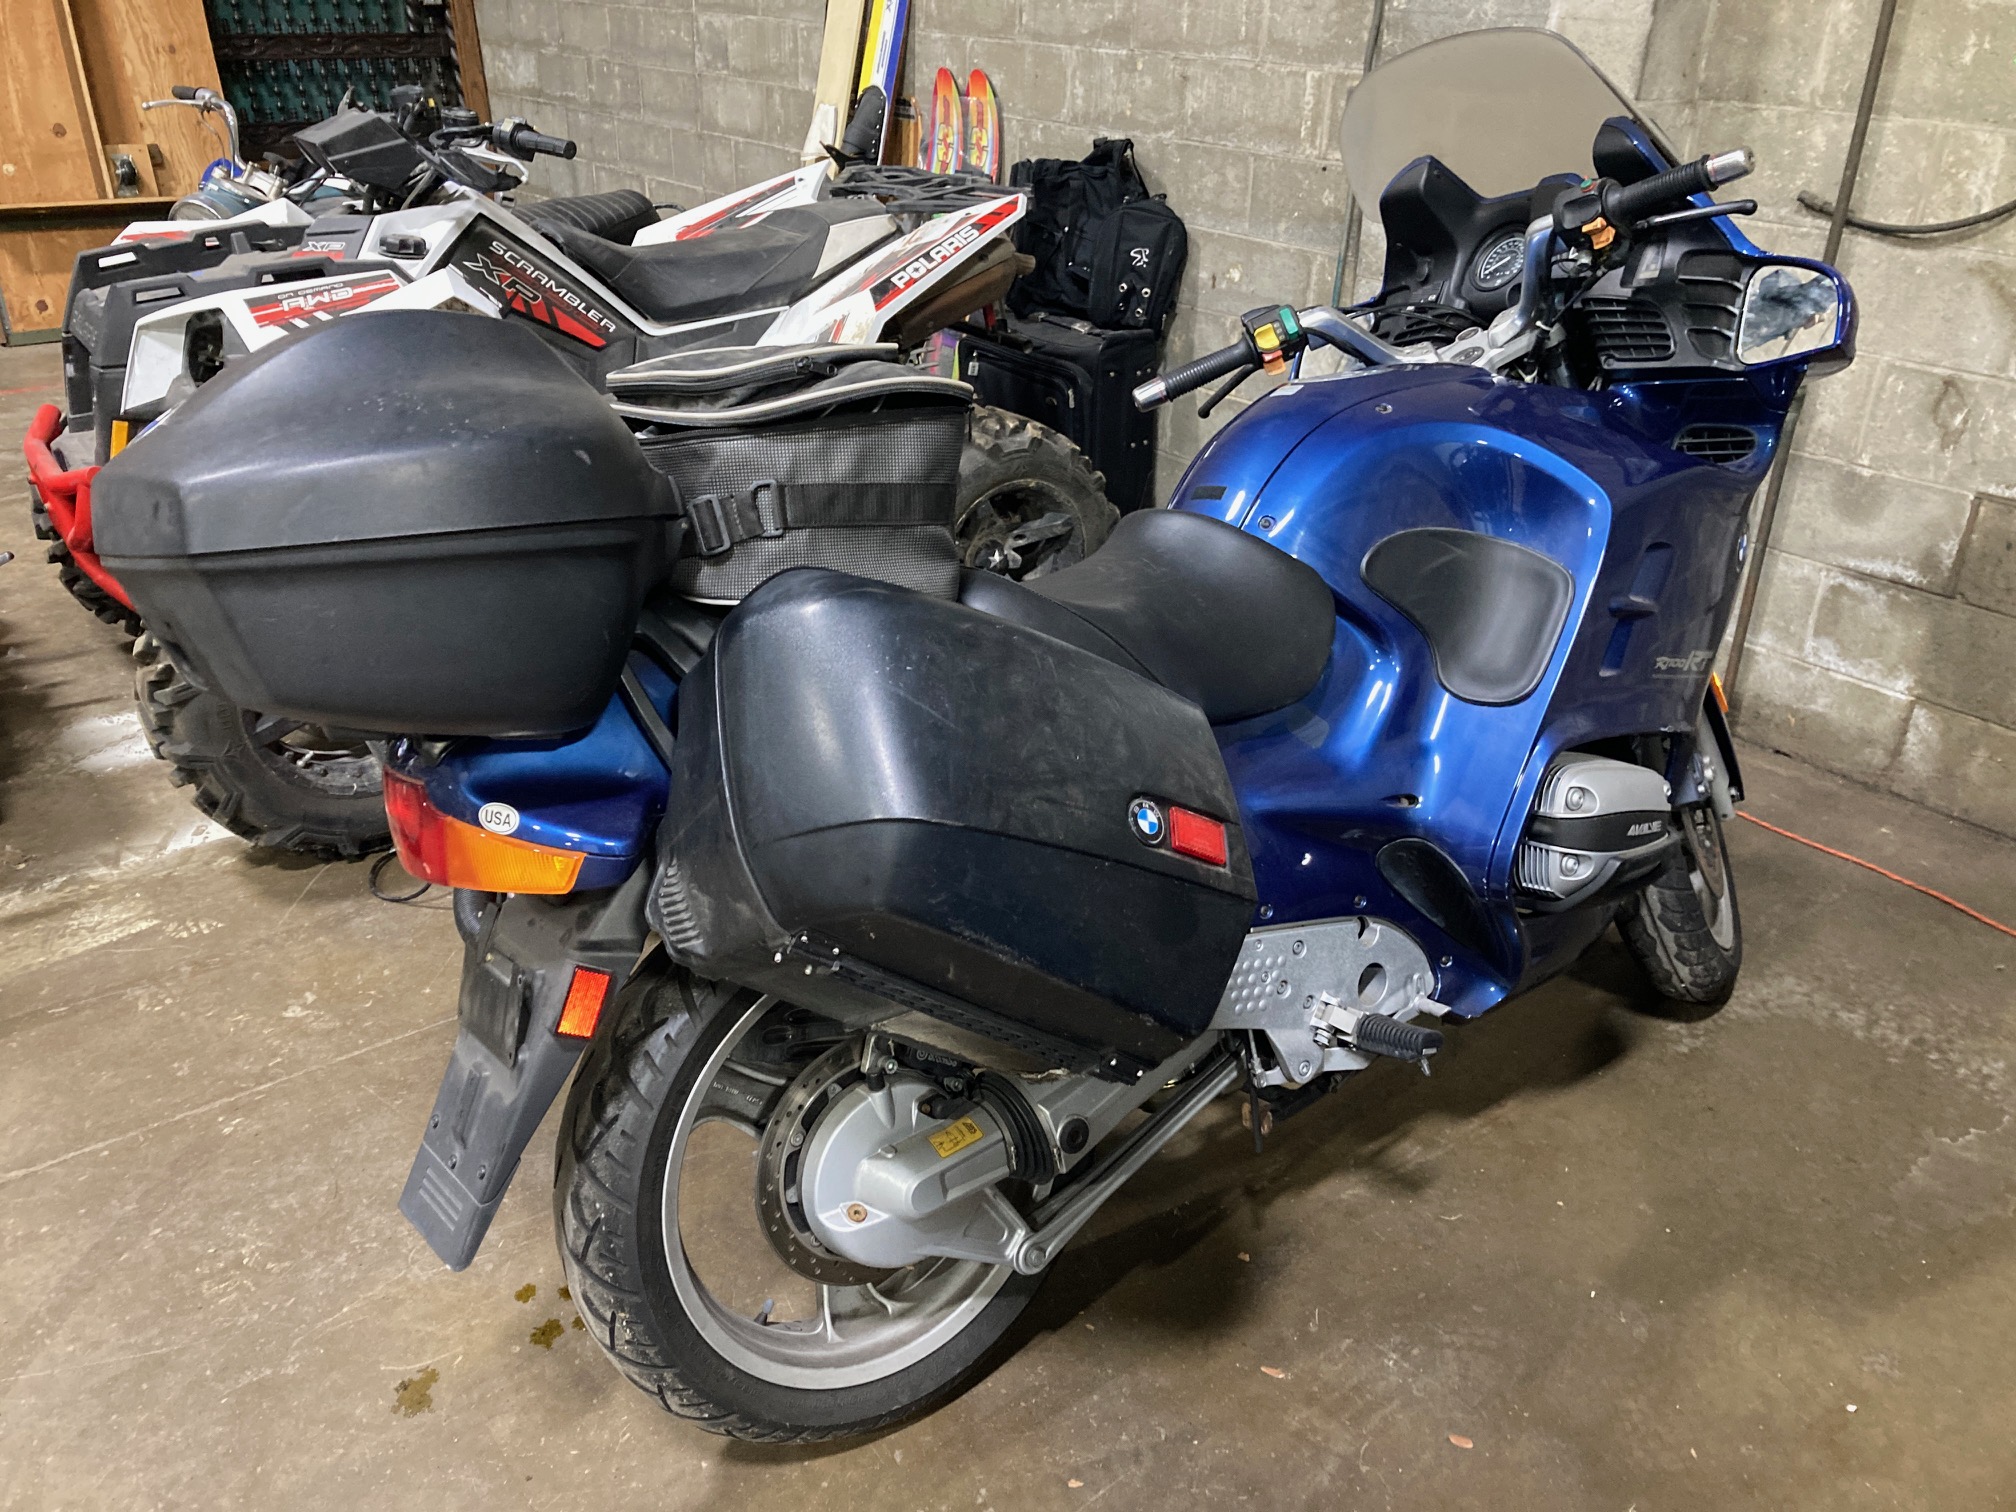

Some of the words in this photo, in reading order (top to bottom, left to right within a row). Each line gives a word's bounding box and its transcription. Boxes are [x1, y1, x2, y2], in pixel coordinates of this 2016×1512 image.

[302, 241, 346, 251] XP
[890, 225, 980, 289] POLARIS
[462, 252, 542, 304] XP
[488, 241, 617, 333] SCRAMBLER
[282, 286, 354, 311] AWD
[485, 809, 511, 827] USA
